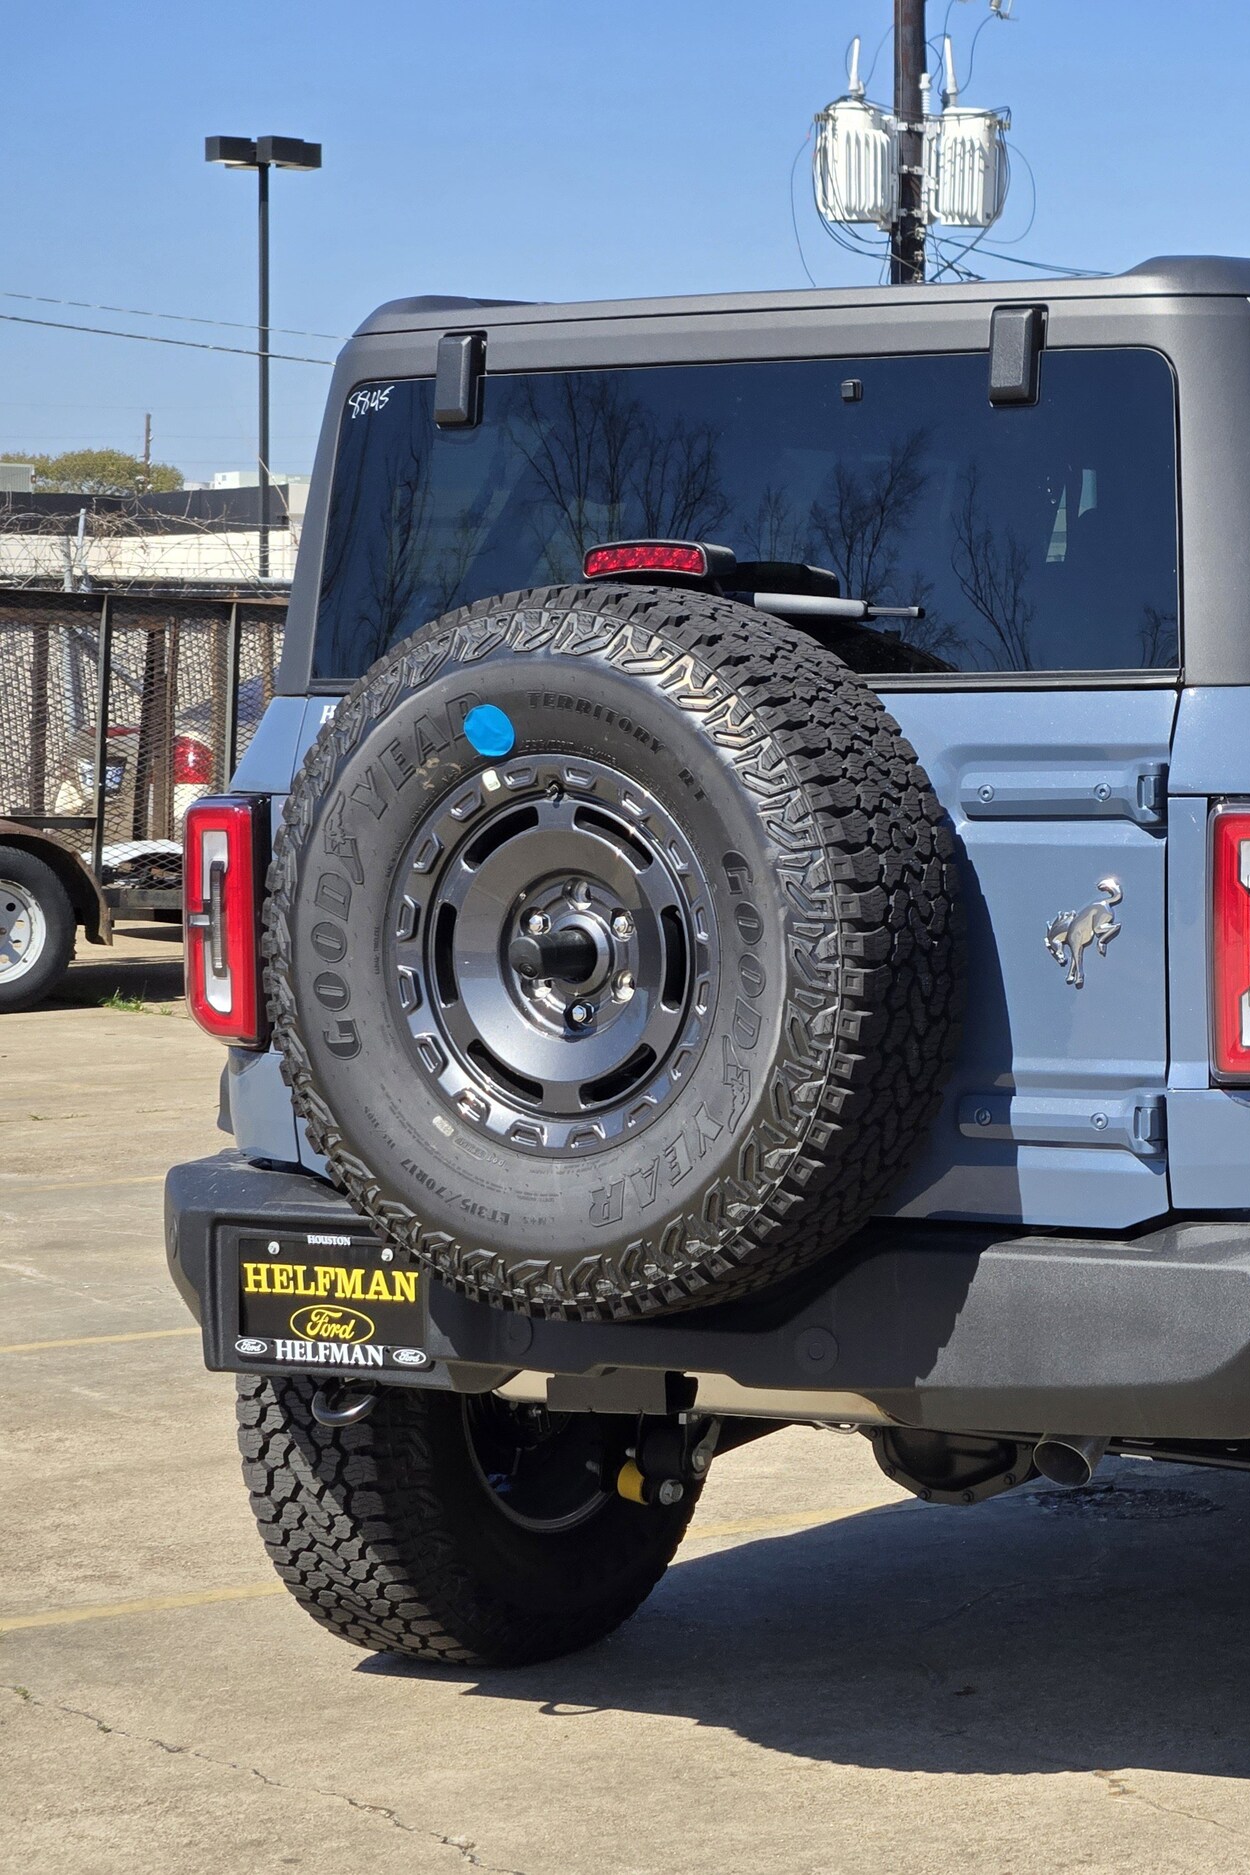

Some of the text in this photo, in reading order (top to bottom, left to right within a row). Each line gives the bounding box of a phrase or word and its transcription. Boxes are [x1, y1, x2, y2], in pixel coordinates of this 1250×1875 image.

[348, 386, 395, 419] 8845
[526, 691, 666, 755] TERRITORY
[677, 767, 708, 801] RT
[589, 850, 766, 1227] GOODYEAR
[400, 1158, 511, 1226] LT315/70R17
[307, 1234, 351, 1246] HOUSTON
[243, 1263, 419, 1303] HELFMAN
[306, 1309, 356, 1340] Ford
[240, 1341, 262, 1353] Ford
[274, 1339, 385, 1367] HELFMAN
[398, 1350, 421, 1362] Ford
